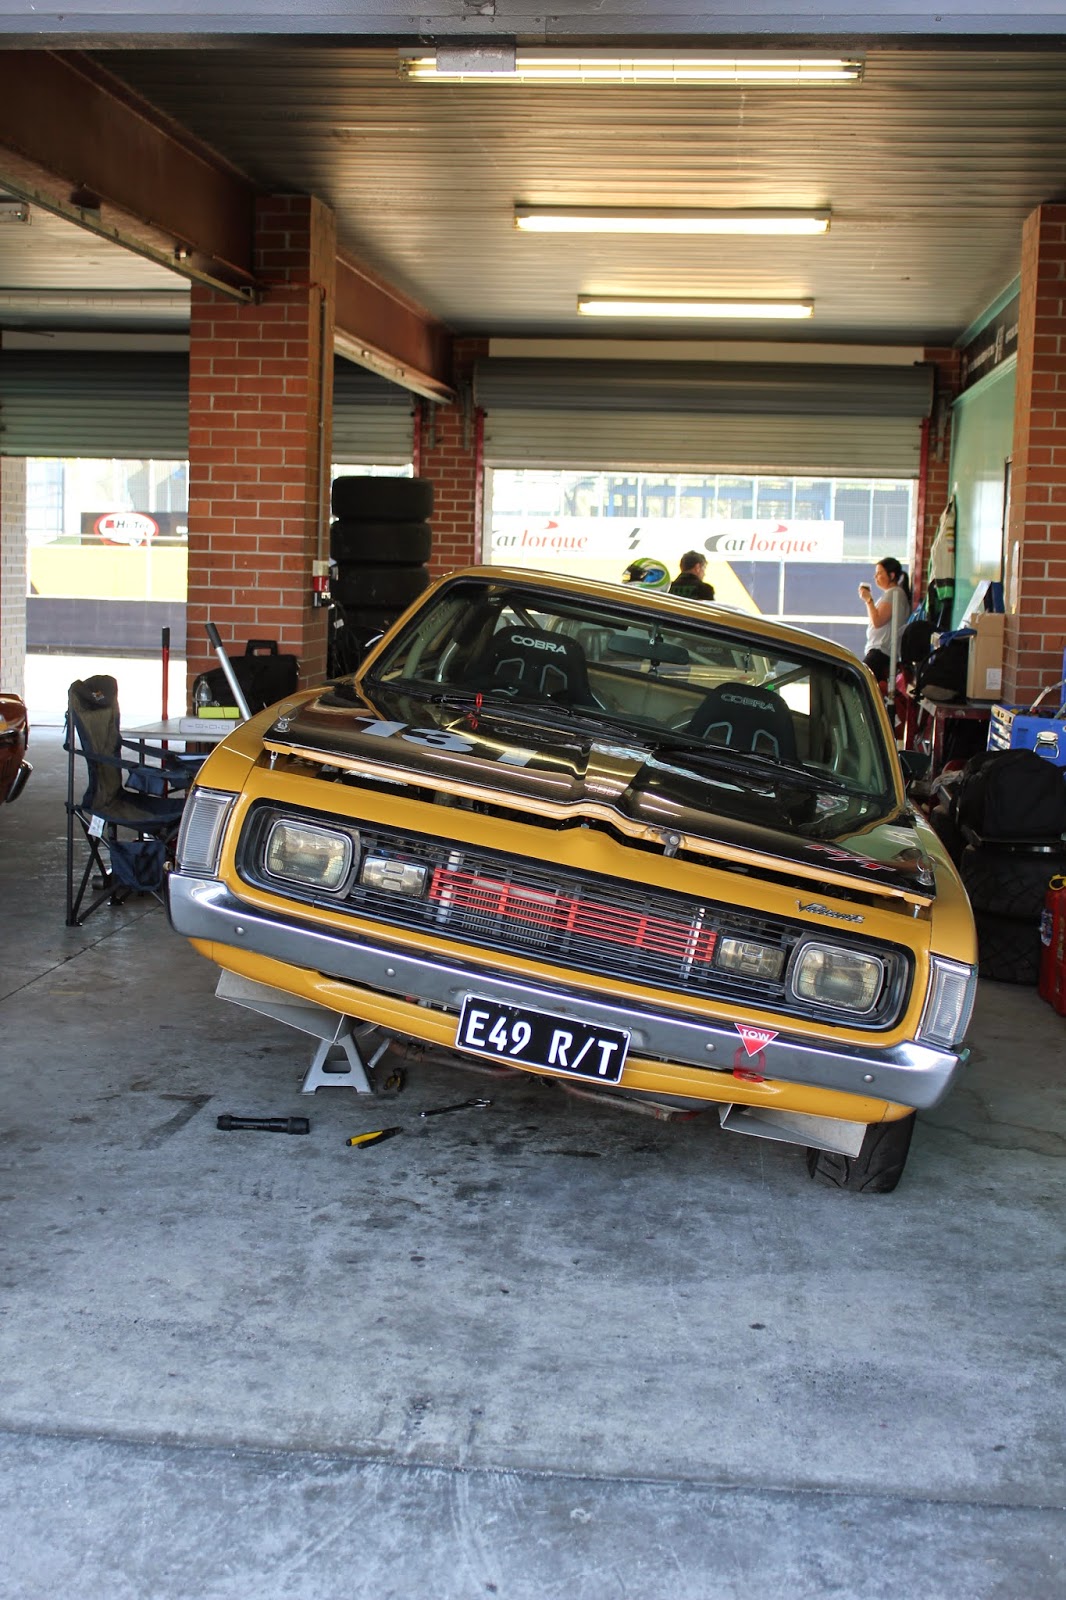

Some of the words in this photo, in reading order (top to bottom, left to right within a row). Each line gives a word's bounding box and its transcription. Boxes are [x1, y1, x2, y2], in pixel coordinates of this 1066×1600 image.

[510, 634, 567, 655] COBRA
[720, 692, 776, 713] COBRA
[465, 1009, 532, 1056] E49
[548, 1029, 619, 1076] R/T
[741, 1028, 770, 1042] TOW
